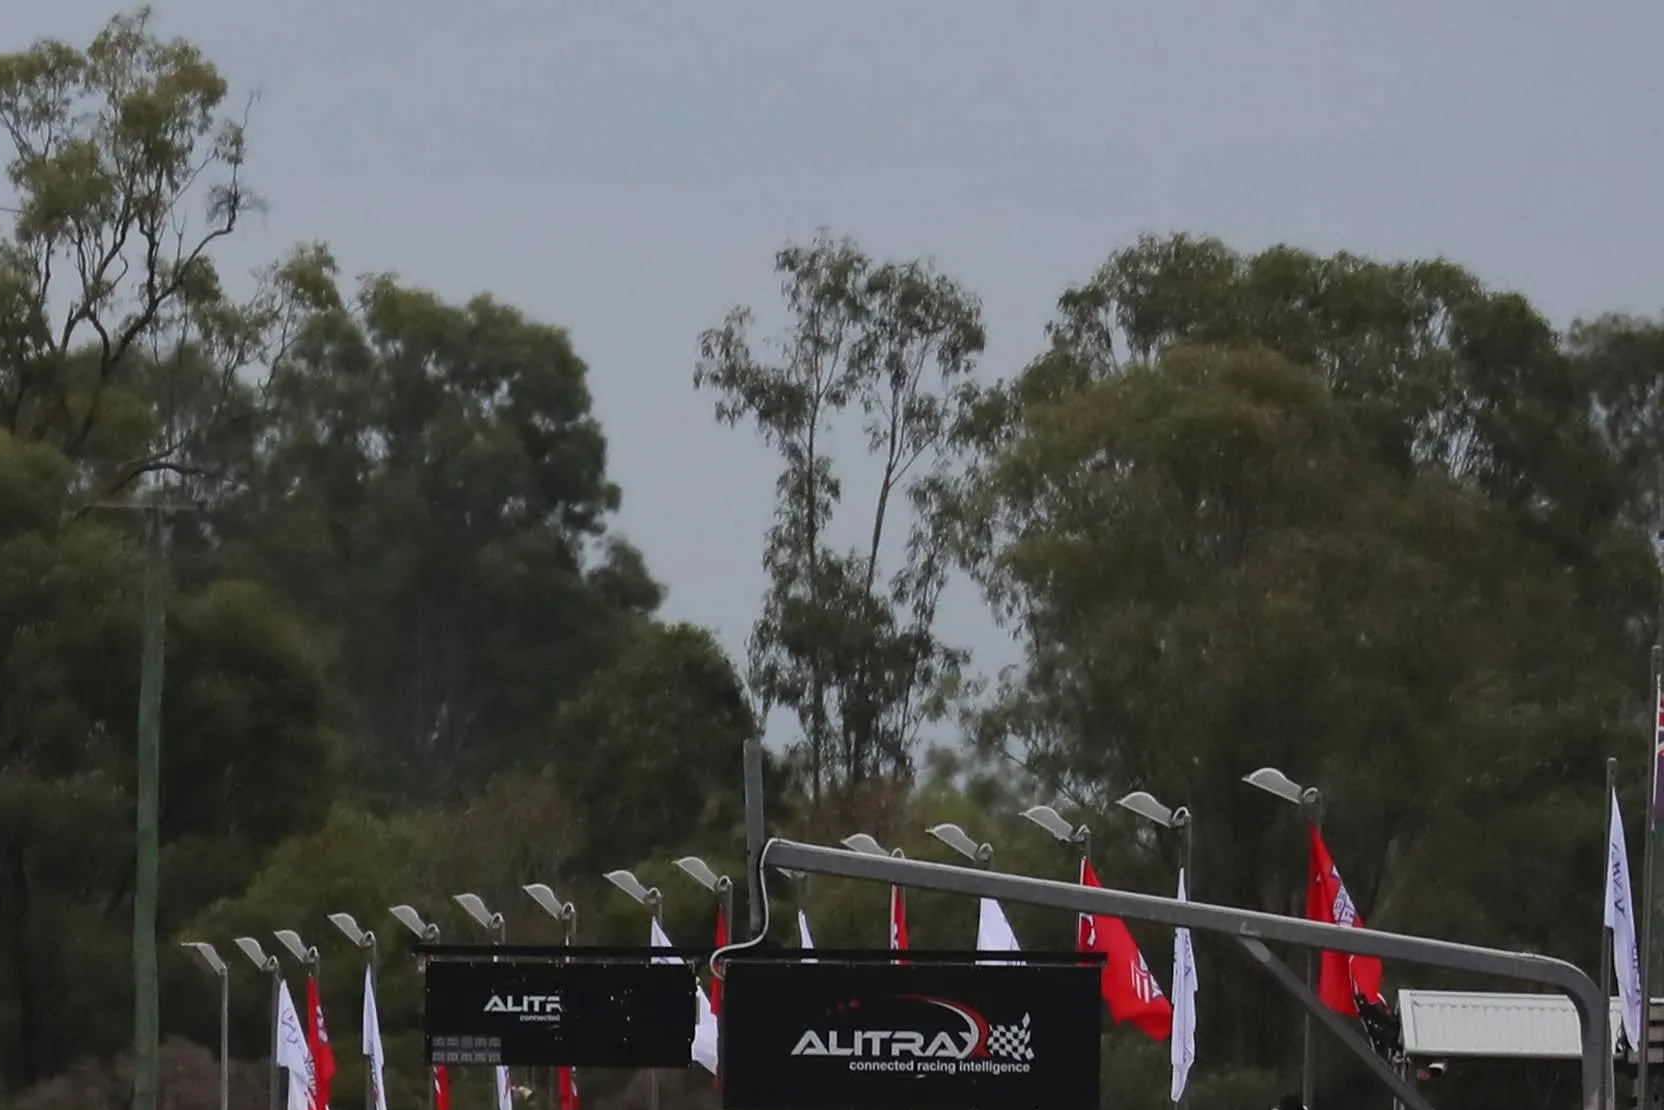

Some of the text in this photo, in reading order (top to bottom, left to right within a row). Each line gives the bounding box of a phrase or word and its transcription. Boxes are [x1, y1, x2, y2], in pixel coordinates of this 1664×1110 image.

[849, 1060, 1031, 1075] connected racing intelligence
